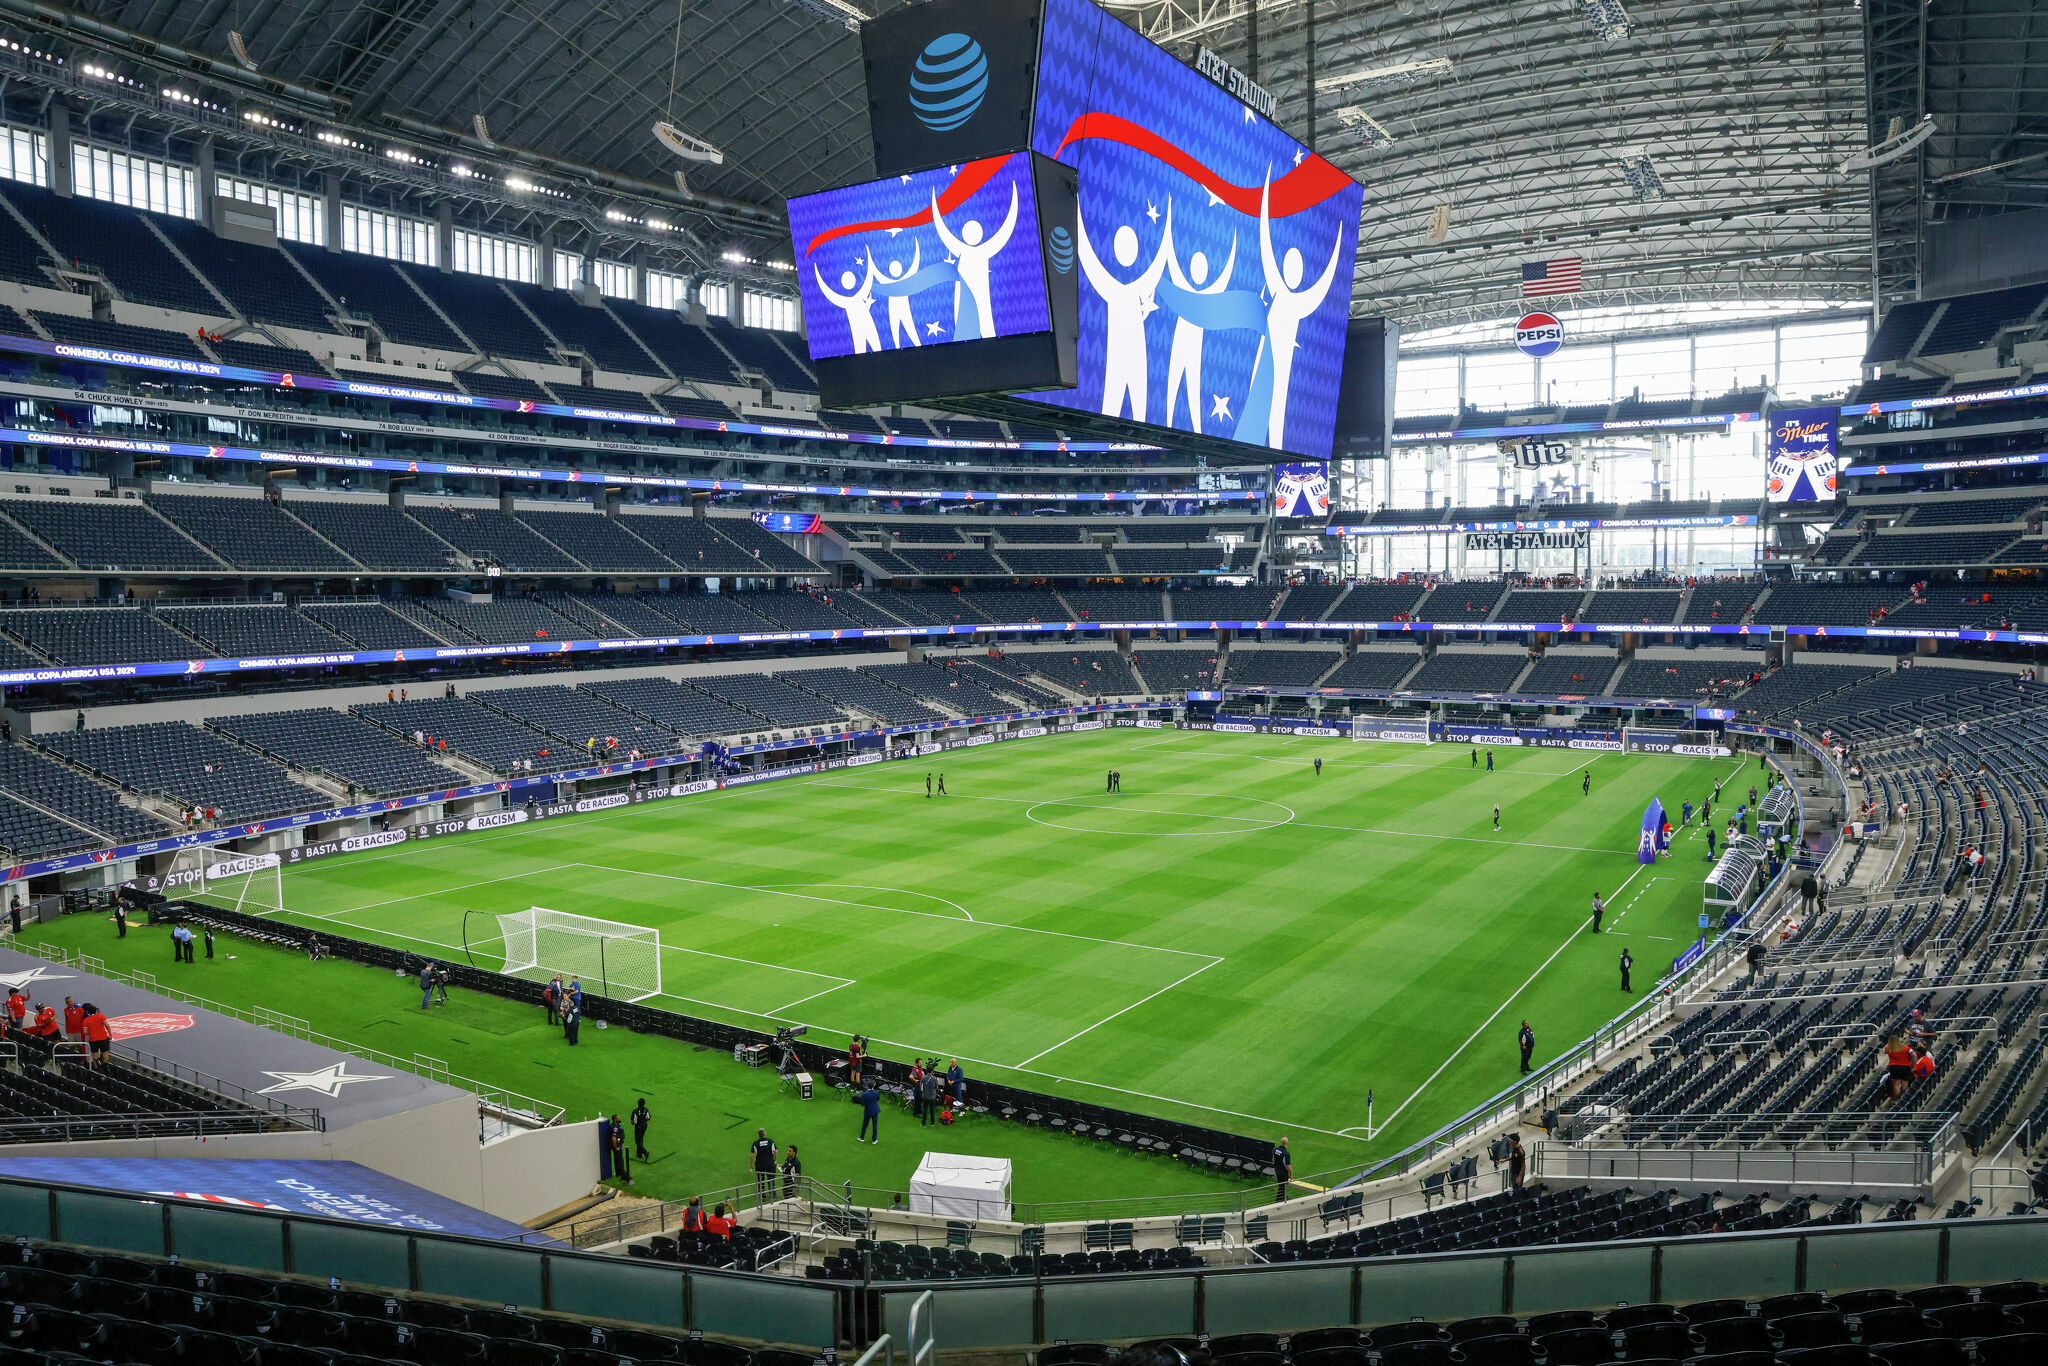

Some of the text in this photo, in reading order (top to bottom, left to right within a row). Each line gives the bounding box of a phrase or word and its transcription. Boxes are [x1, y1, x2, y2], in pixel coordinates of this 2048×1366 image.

[1196, 46, 1277, 120] AT&T STADIUM
[1517, 329, 1560, 341] PEPSI
[55, 345, 221, 375] CONMEBOL COPA AMERICA USA 2024
[88, 394, 112, 402] CHUCK
[114, 396, 143, 405] HOWLEY
[349, 384, 473, 404] CONMEBOL COPA AMERICA USA 2024
[1912, 385, 2048, 408] CONMEBOL COPA AMERICA USA 2024
[263, 412, 294, 421] MEREDITH
[574, 409, 607, 419] CONMEBOL
[625, 414, 650, 423] AMERICA
[651, 416, 662, 424] USA
[662, 417, 676, 425] 2024
[1603, 421, 1641, 429] CONMEBOL
[1660, 418, 1692, 426] AMERICA
[1776, 422, 1830, 444] Miller
[28, 433, 170, 452] CONMEBOL COPA AMERICA USA 2024
[260, 453, 298, 462] CONMEBOL
[298, 455, 316, 463] COPA
[315, 457, 344, 466] AMERICA
[1514, 444, 1566, 470] Lite
[1771, 460, 1836, 477] Lite Lite
[1923, 462, 1959, 470] CONMEBOL
[1960, 460, 1978, 468] COPA
[1277, 482, 1328, 497] Lite Lite
[1602, 519, 1640, 527] CONMEBOL
[1468, 533, 1589, 549] AT&T STADIUM
[239, 659, 278, 668] CONMEBOL
[296, 656, 326, 665] AMERICA
[37, 670, 61, 680] COPA
[61, 669, 98, 679] AMERICA
[100, 668, 116, 676] USA
[117, 667, 136, 675] 2024
[1004, 728, 1041, 740] STOP RACISM
[1058, 724, 1072, 732] BASTA
[1082, 721, 1103, 730] RACISMO
[1302, 728, 1331, 736] RACISM
[969, 738, 975, 746] DE
[1394, 732, 1426, 740] RACISMO
[1446, 734, 1512, 744] STOP RACISM
[1542, 739, 1566, 747] BASTA
[1584, 741, 1621, 750] RACISMO
[1644, 744, 1719, 755] STOP RACISM
[829, 760, 846, 769] BASTA
[858, 754, 881, 764] RACISMO
[727, 766, 812, 786] CONMEBOL COPA AMERICA USA 2024
[648, 782, 708, 799] STOP RACISM
[548, 796, 626, 816] BASTA DE RACISMO
[435, 813, 516, 835] STOP RACISM
[306, 831, 404, 858] BASTA DE RACISMO
[168, 857, 266, 887] STOP RACISM
[276, 1178, 393, 1221] AMERICA
